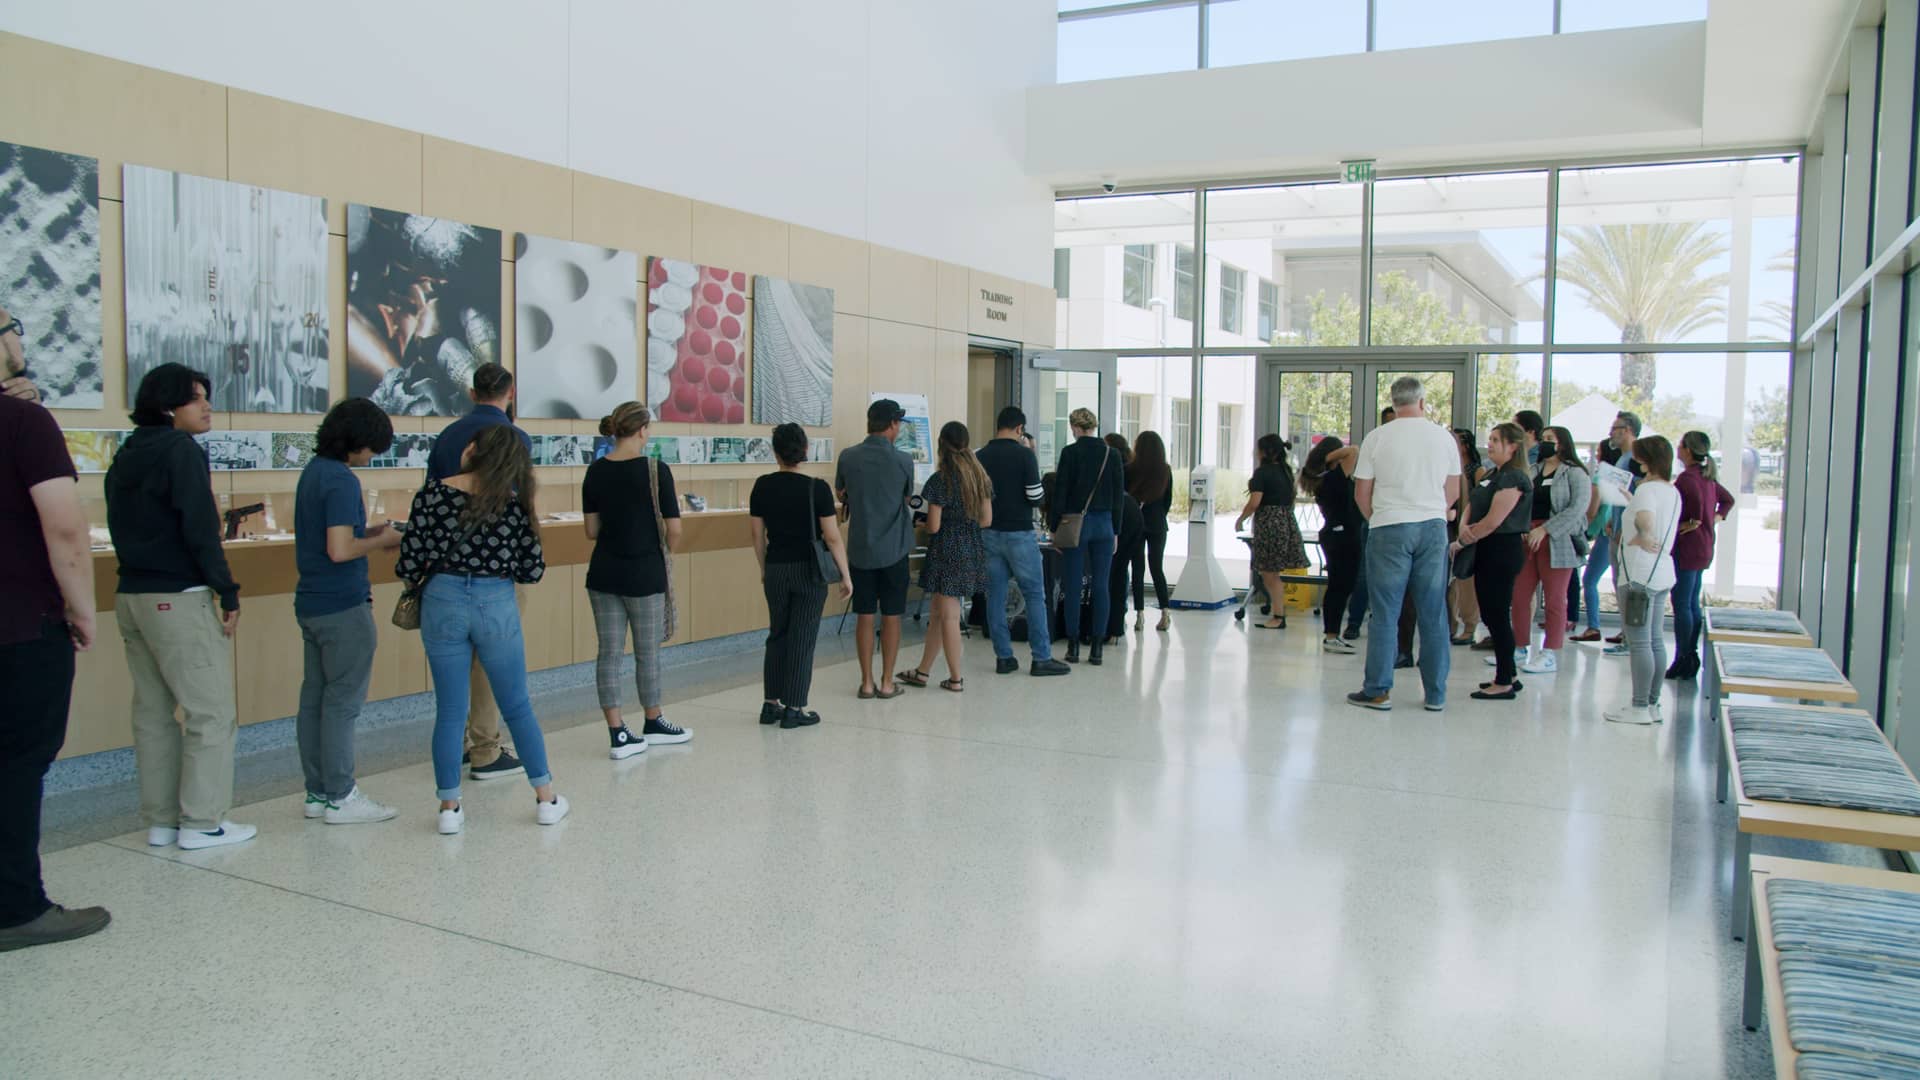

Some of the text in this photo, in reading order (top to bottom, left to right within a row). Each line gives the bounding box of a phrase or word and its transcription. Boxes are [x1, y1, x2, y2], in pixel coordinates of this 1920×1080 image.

[1347, 161, 1373, 182] EXIT
[980, 288, 1013, 306] TRAINING
[304, 312, 320, 328] 20
[986, 307, 1007, 322] ROOM
